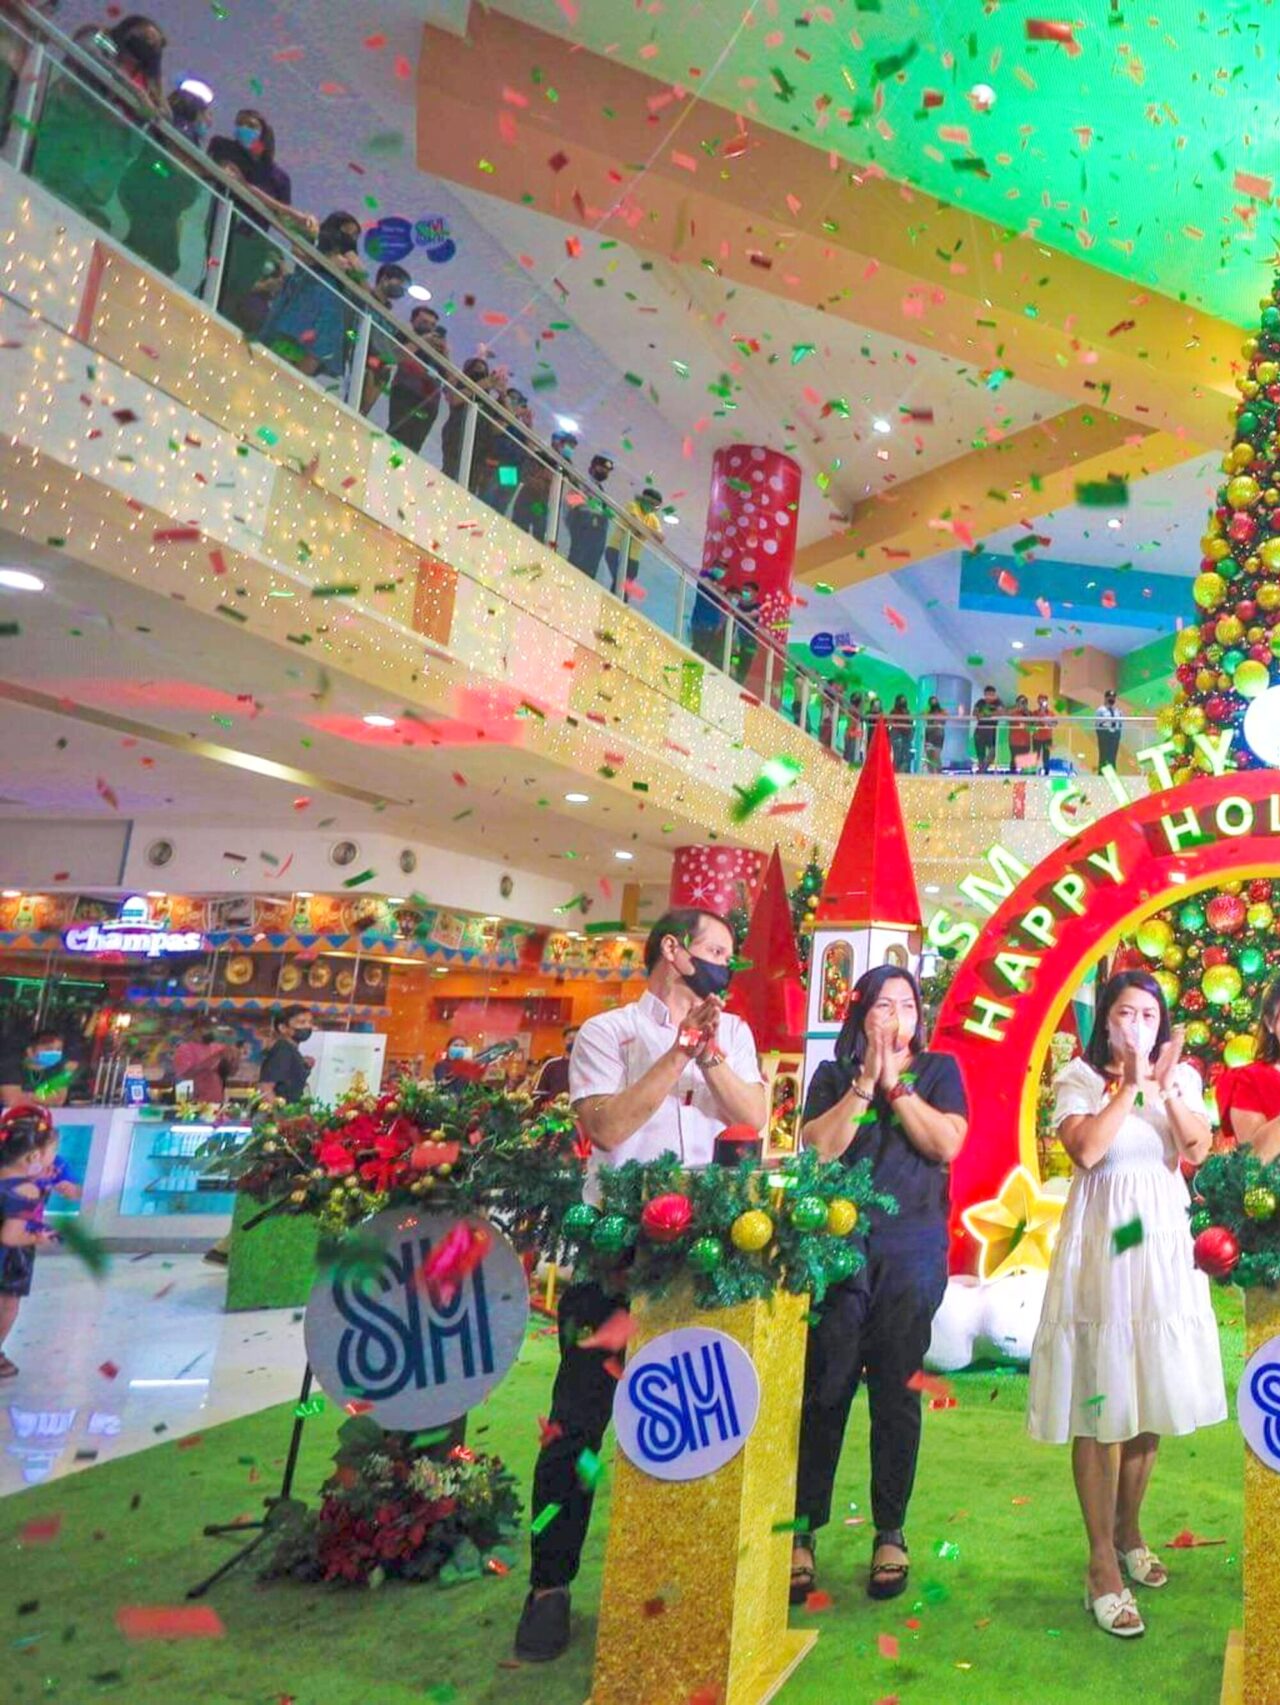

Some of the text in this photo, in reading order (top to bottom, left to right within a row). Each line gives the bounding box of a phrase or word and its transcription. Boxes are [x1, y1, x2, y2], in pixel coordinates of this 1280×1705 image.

[927, 843, 1033, 960] SM
[1049, 728, 1235, 837] CITY
[963, 840, 1126, 1042] HAPPY
[332, 1234, 495, 1401] SM
[628, 1341, 741, 1463] SM
